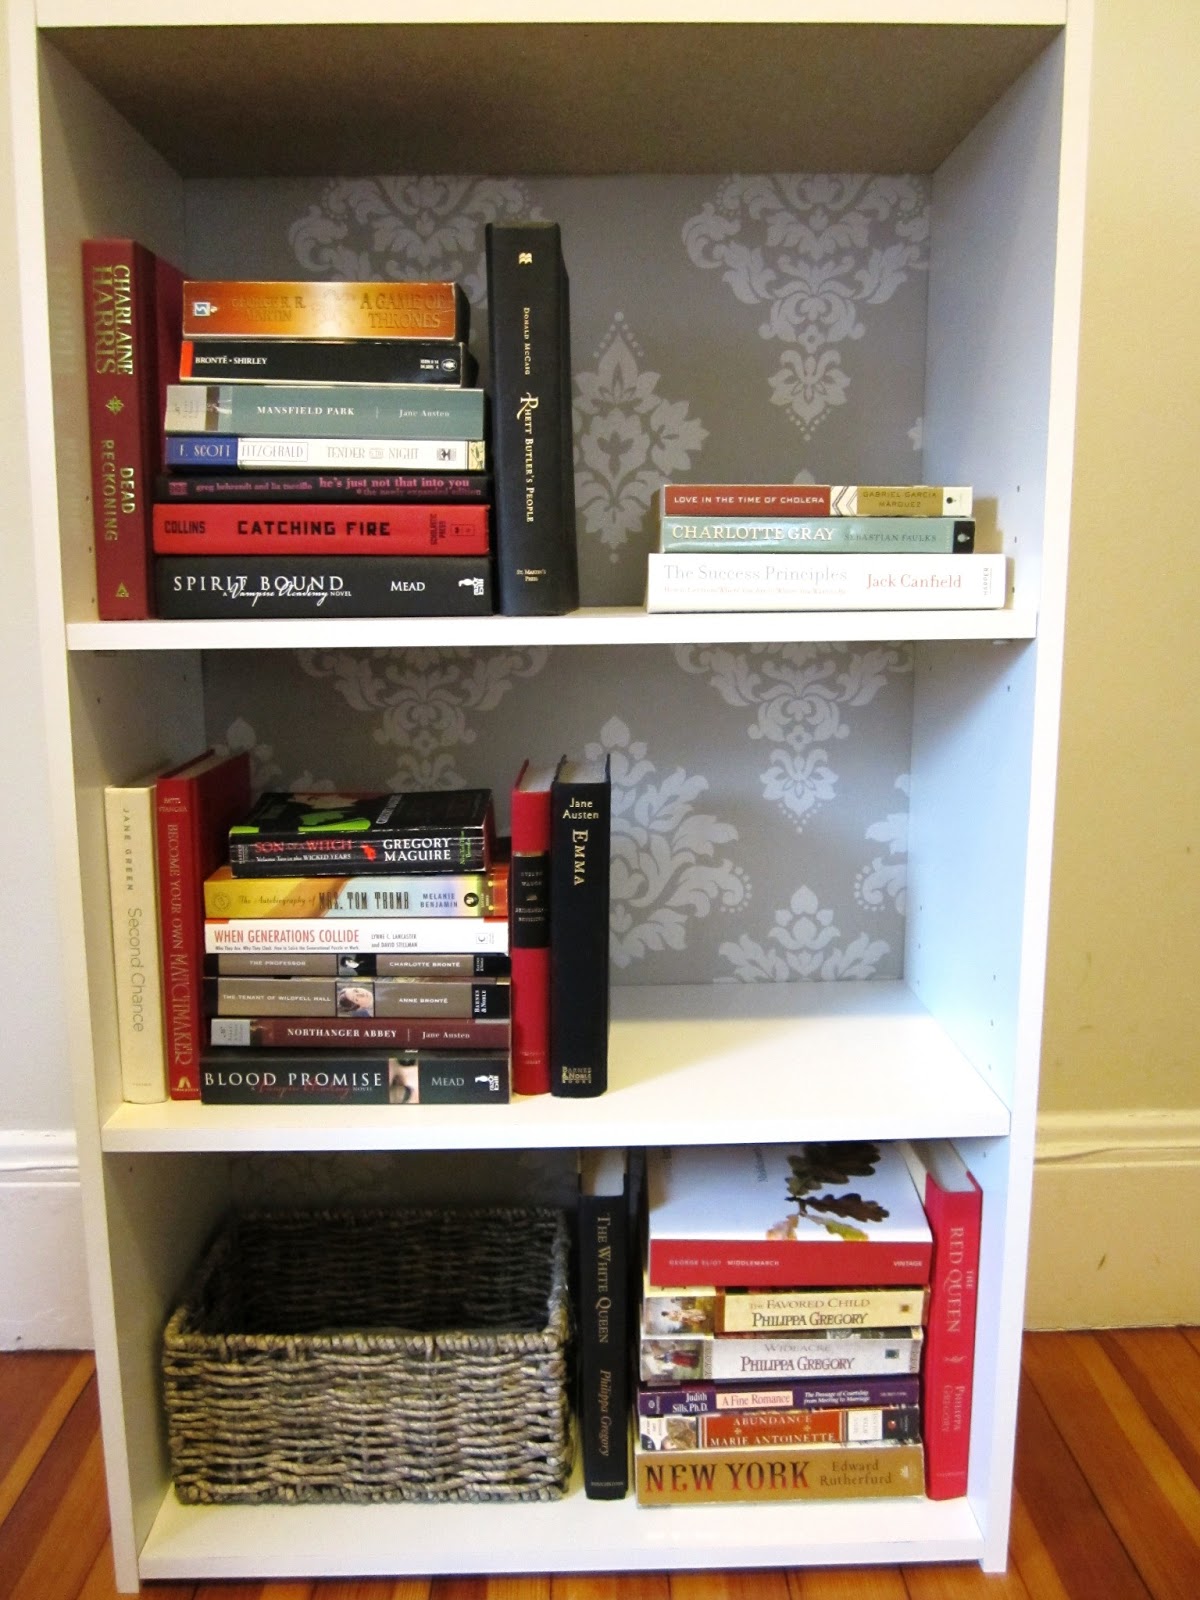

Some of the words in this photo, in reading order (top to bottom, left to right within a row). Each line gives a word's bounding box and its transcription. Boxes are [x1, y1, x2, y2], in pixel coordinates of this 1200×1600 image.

[360, 293, 372, 310] A
[375, 293, 419, 310] GAME
[424, 293, 446, 310] OF
[93, 266, 113, 375] HARRIS
[112, 264, 133, 375] CHARLAINE
[368, 312, 441, 329] THRONES
[233, 357, 268, 365] SHIRLEY
[257, 406, 323, 415] MANSFIELD
[327, 407, 355, 416] PARK
[399, 409, 419, 418] Jane
[421, 409, 450, 417] Austen
[194, 444, 231, 457] SCOTT
[241, 445, 304, 458] FITZGERALD
[327, 446, 365, 460] TENDER
[388, 447, 419, 460] NIGHT
[101, 439, 118, 542] RECKONING
[119, 467, 136, 514] DEAD
[319, 477, 342, 488] he's
[346, 477, 367, 490] just
[371, 478, 390, 488] not
[394, 477, 417, 488] that
[421, 477, 444, 488] into
[448, 479, 470, 490] you
[674, 496, 698, 504] LOVE
[701, 496, 712, 504] IN
[715, 496, 734, 504] THE
[738, 496, 762, 504] TIME
[764, 496, 778, 504] OF
[780, 496, 825, 504] CHOLERA
[164, 520, 206, 534] COLLINS
[237, 521, 336, 536] CATCHING
[346, 521, 391, 536] FIRE
[672, 525, 785, 541] CHARLOTTE
[787, 526, 834, 541] GRAY
[902, 534, 937, 542] FAULKS
[663, 564, 694, 580] The
[698, 565, 760, 581] Success
[765, 565, 848, 586] Principles
[867, 573, 897, 590] Jack
[900, 573, 962, 588] Canfield
[174, 575, 248, 591] SPIRIT
[260, 575, 344, 591] BOUND
[390, 581, 426, 592] MEAD
[228, 579, 275, 607] Vampire
[278, 580, 329, 607] Academy
[569, 797, 593, 808] Jane
[562, 809, 599, 820] Austen
[123, 808, 132, 841] JANE
[167, 824, 181, 877] BECOME
[255, 841, 285, 853] SON
[305, 839, 353, 851] WITCH
[383, 837, 452, 850] GREGORY
[384, 849, 452, 862] MAGUIRE
[572, 829, 589, 886] EMMA
[125, 848, 134, 891] GREEN
[169, 881, 183, 914] YOUR
[254, 895, 307, 908] Autobiography
[347, 892, 368, 910] TOM
[420, 900, 458, 908] BENJAMIN
[128, 906, 145, 968] Second
[171, 918, 184, 950] OWN
[214, 930, 244, 943] WHEN
[248, 929, 315, 943] GENERATIONS
[319, 929, 360, 943] COLLIDE
[130, 972, 146, 1033] Chance
[169, 954, 193, 1066] MATCHMAKER
[287, 1028, 360, 1038] NORTHANGER
[363, 1029, 397, 1038] ABBEY
[422, 1031, 440, 1039] Jane
[443, 1031, 471, 1039] Austen
[204, 1072, 277, 1087] BLOOD
[288, 1072, 382, 1087] PROMISE
[431, 1077, 465, 1087] MEAD
[949, 1227, 964, 1264] RED
[966, 1270, 974, 1289] THE
[944, 1268, 964, 1333] QUEEN
[599, 1369, 612, 1412] Philippa
[685, 1392, 708, 1403] Judith
[689, 1403, 709, 1412] Ph.D.
[722, 1396, 730, 1407] A
[731, 1395, 749, 1406] Fine
[751, 1393, 790, 1405] Romance
[733, 1415, 813, 1426] ABUNDANCE
[599, 1415, 612, 1457] Gregory
[710, 1436, 748, 1447] MARIE
[755, 1433, 835, 1444] ANTOINETTE
[831, 1459, 880, 1472] Edward
[645, 1463, 717, 1493] NEW
[725, 1461, 810, 1491] YORK
